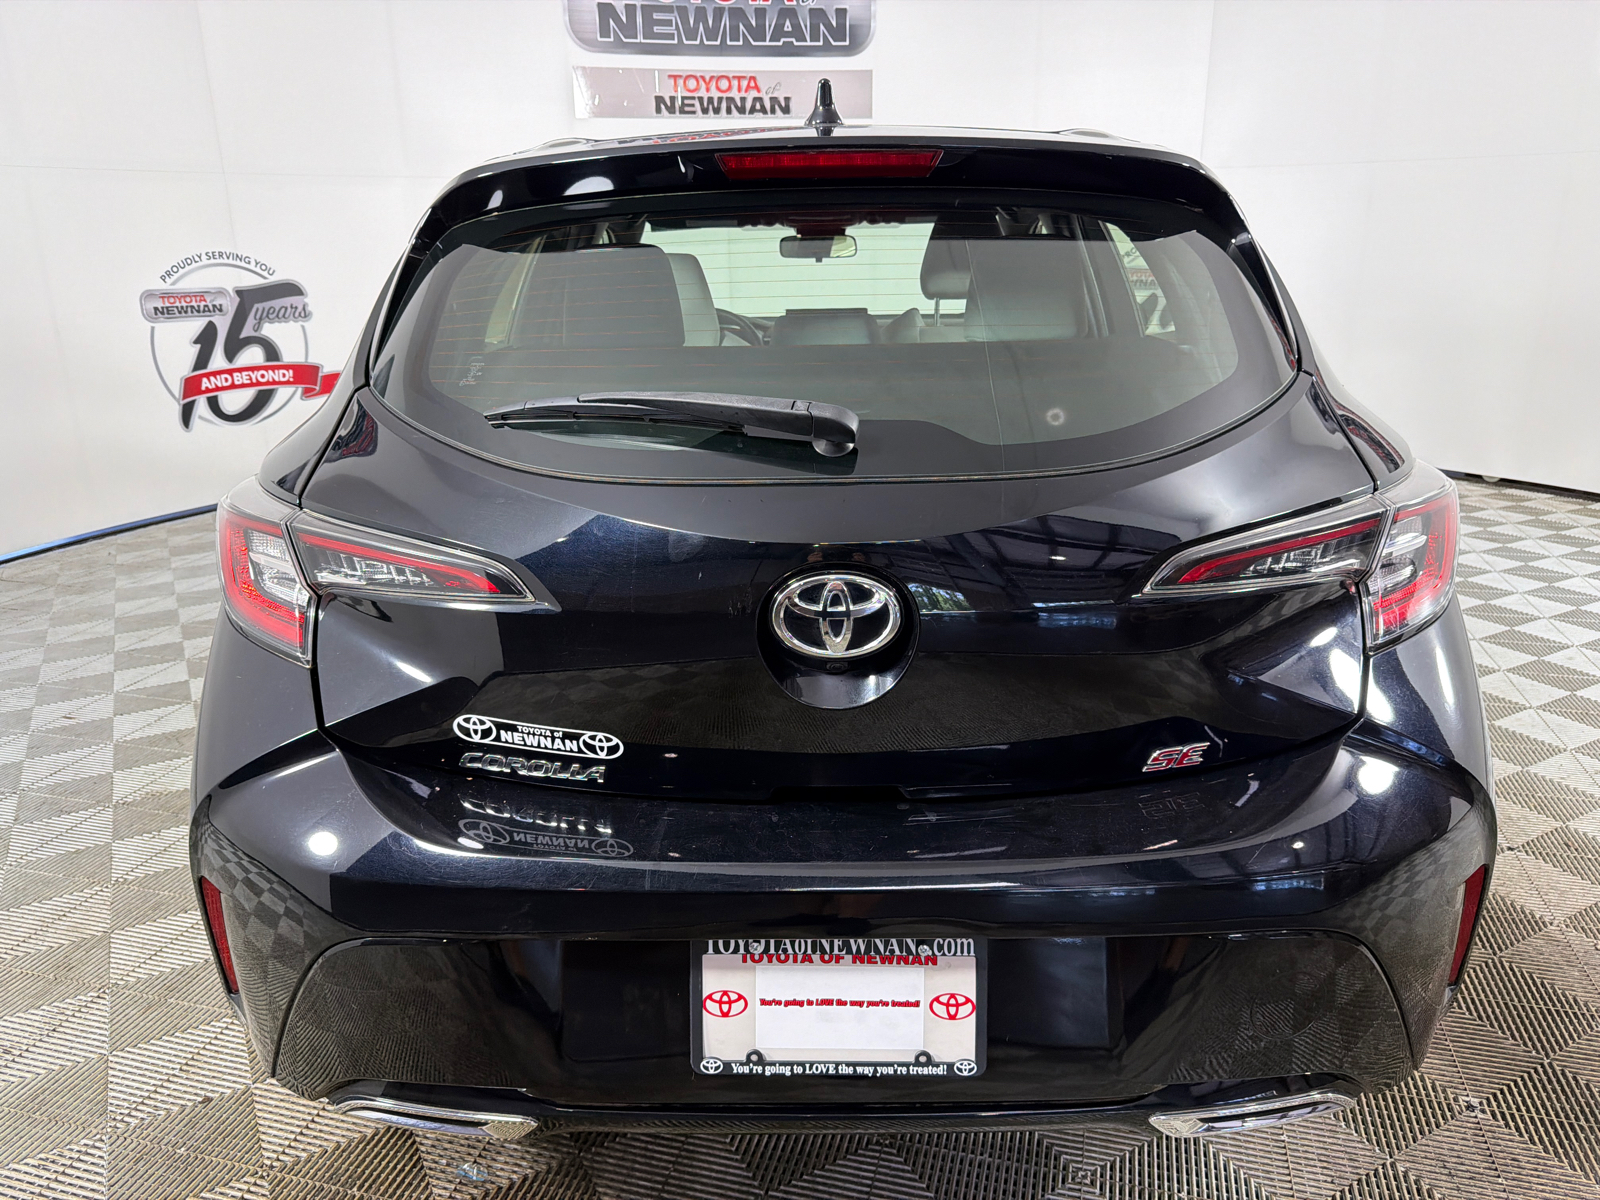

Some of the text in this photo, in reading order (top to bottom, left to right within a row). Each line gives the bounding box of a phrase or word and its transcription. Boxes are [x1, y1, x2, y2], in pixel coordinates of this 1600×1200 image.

[597, 3, 849, 45] NEWNAN
[667, 74, 761, 94] TOYOTA
[654, 95, 791, 115] NEWNAN
[159, 251, 276, 284] PROUDLY SERVING YOU
[153, 303, 223, 316] NEWNAN
[159, 295, 208, 305] TOYOTA
[181, 281, 309, 429] 15 years
[201, 369, 294, 390] AND BEYOND!
[500, 729, 578, 752] NEWNAN
[517, 726, 552, 736] TOYOTA
[1142, 742, 1210, 772] SE
[459, 752, 606, 783] COROLLA
[742, 953, 938, 966] TOYOTA OF NEWNAN
[759, 998, 921, 1008] You're going to LOVE the way you're treated!
[731, 1062, 948, 1078] You're going to LOVE the way you're treated!
